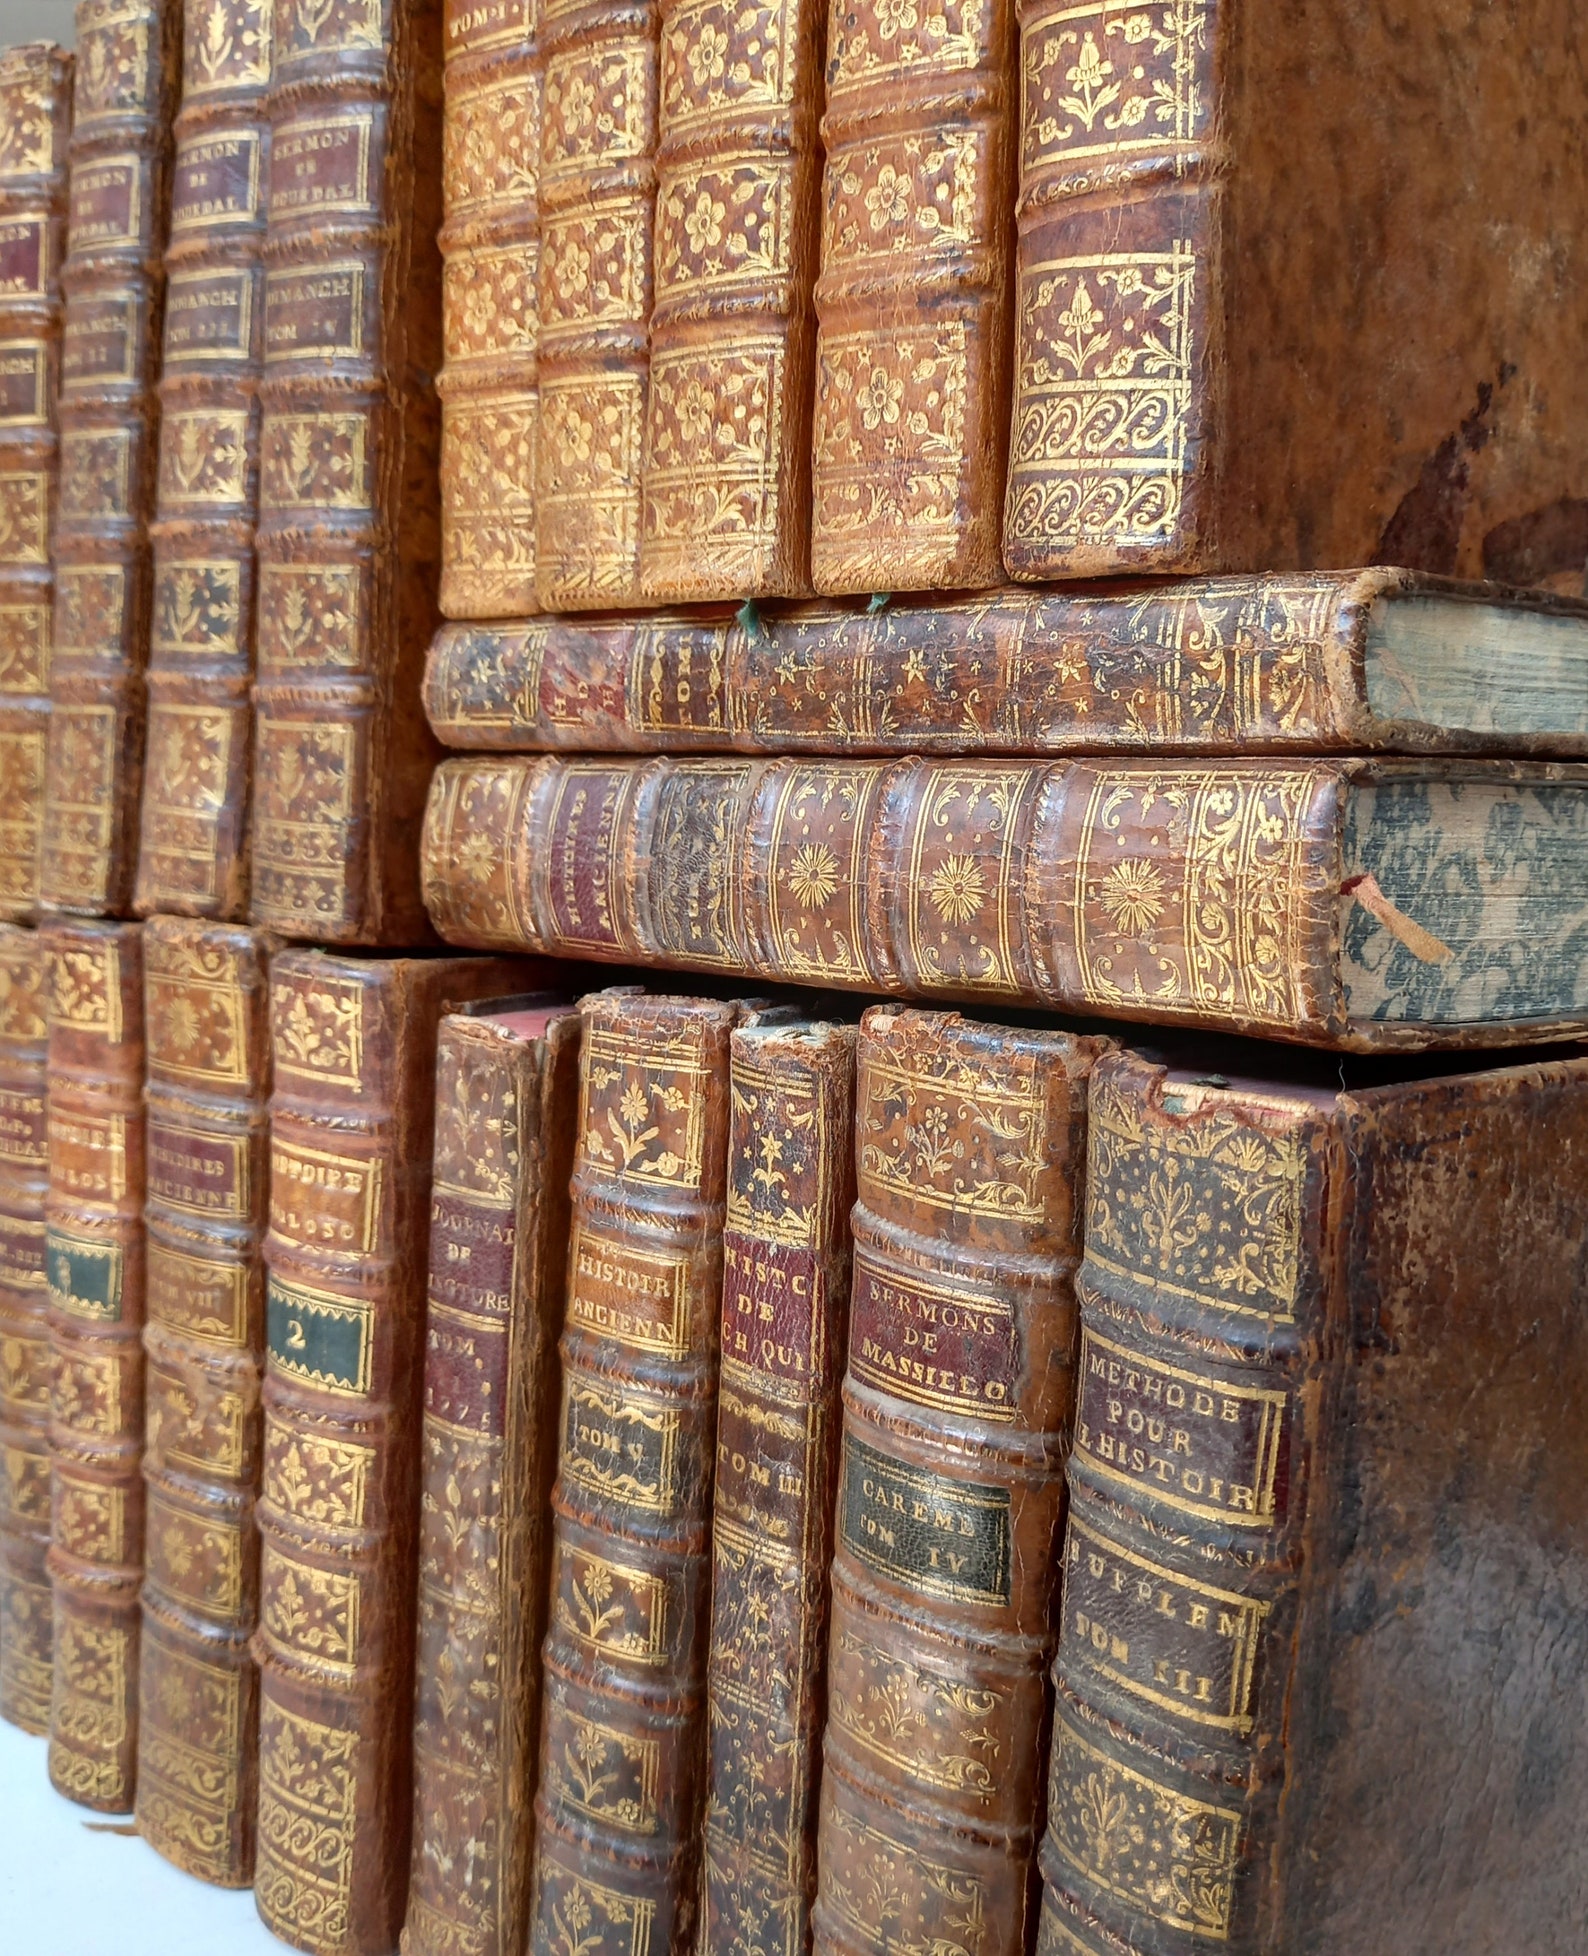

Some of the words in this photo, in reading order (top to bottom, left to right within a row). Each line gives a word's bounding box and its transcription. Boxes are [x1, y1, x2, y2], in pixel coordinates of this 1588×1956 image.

[574, 1297, 676, 1341] ANCIENN
[737, 1293, 775, 1322] DE
[869, 1280, 996, 1336] SERMONS
[286, 1320, 306, 1350] 2
[903, 1326, 938, 1353] DE
[861, 1336, 1006, 1400] MASSILLO
[1090, 1353, 1241, 1423] METHODE
[579, 1424, 621, 1454] TOM
[627, 1442, 644, 1462] V
[1106, 1399, 1193, 1457] POUR
[718, 1441, 771, 1488] TOM
[863, 1479, 976, 1537] CAREME
[928, 1546, 969, 1575] IV
[1075, 1611, 1130, 1665] TOM
